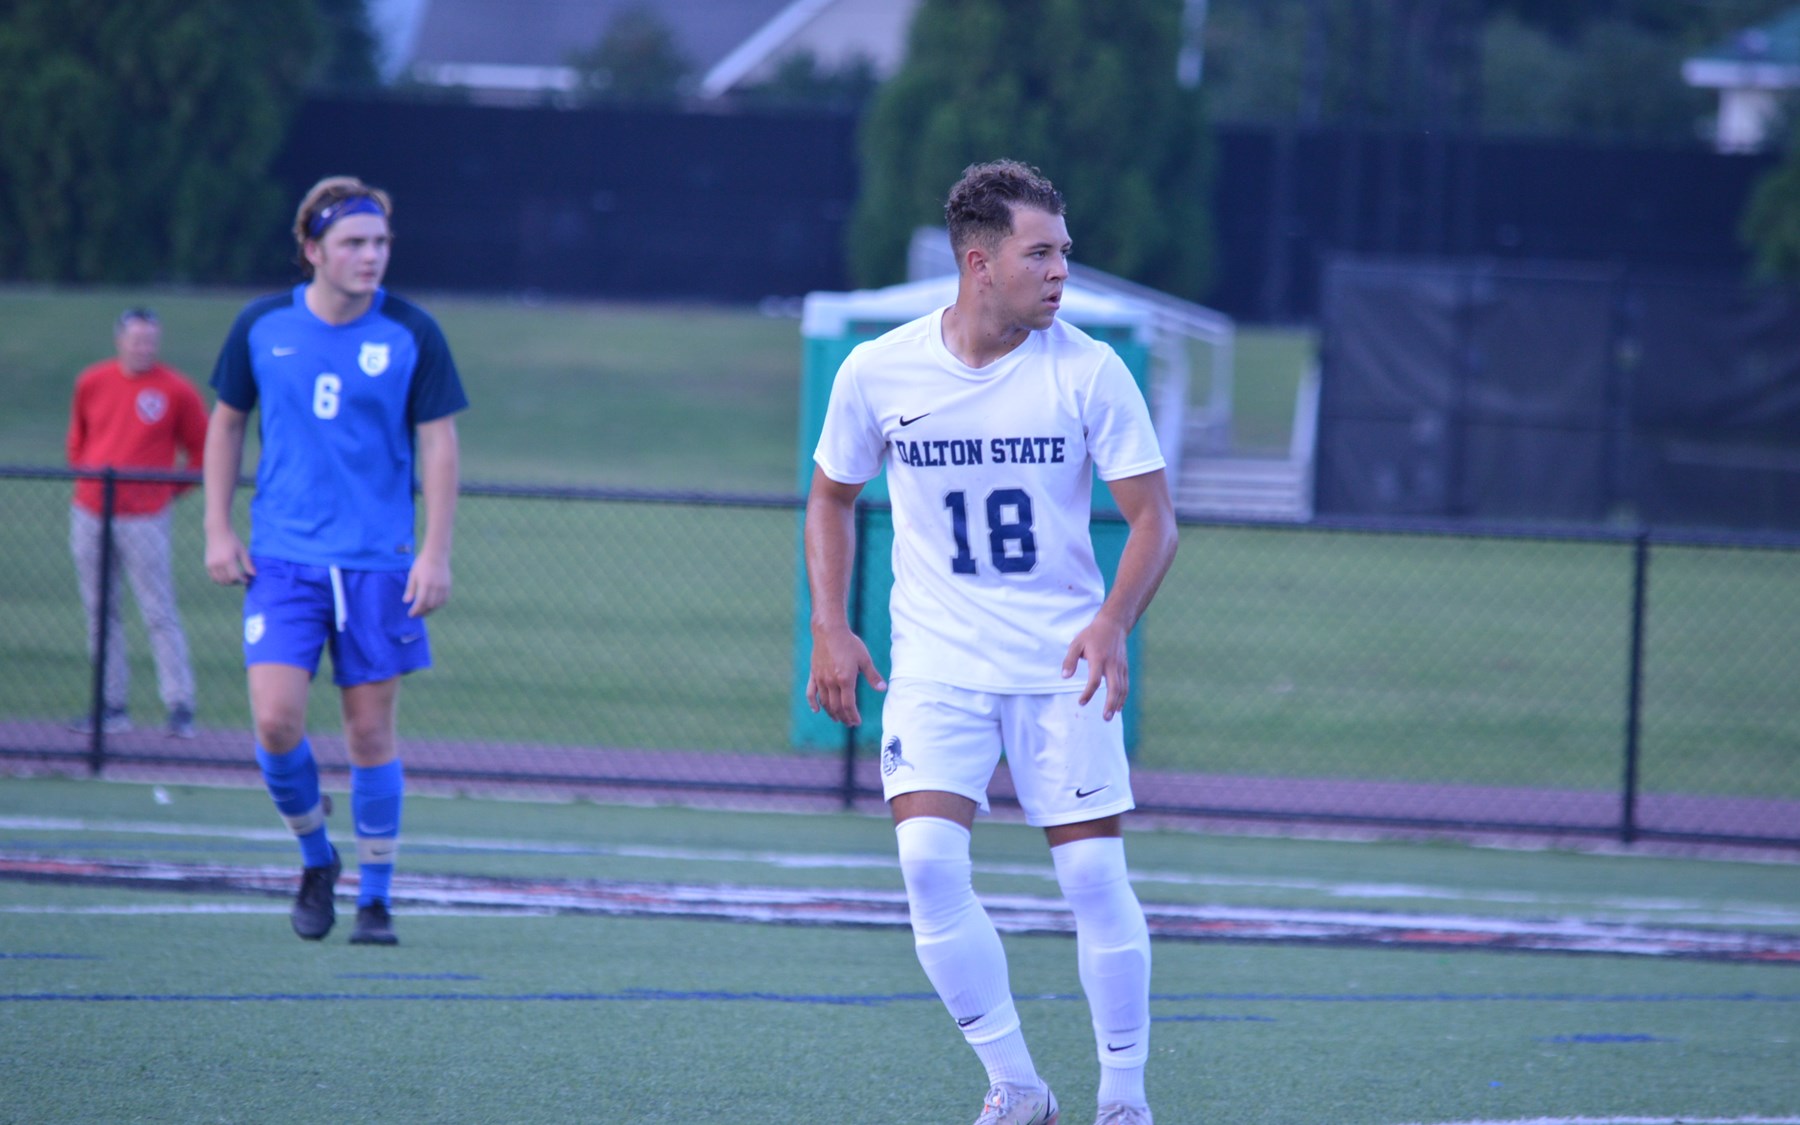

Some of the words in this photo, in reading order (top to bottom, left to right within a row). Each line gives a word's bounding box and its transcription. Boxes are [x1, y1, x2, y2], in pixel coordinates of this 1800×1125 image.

[313, 373, 342, 420] 6
[895, 439, 983, 467] DALTON
[990, 437, 1066, 464] STATE
[943, 488, 1039, 576] 18
